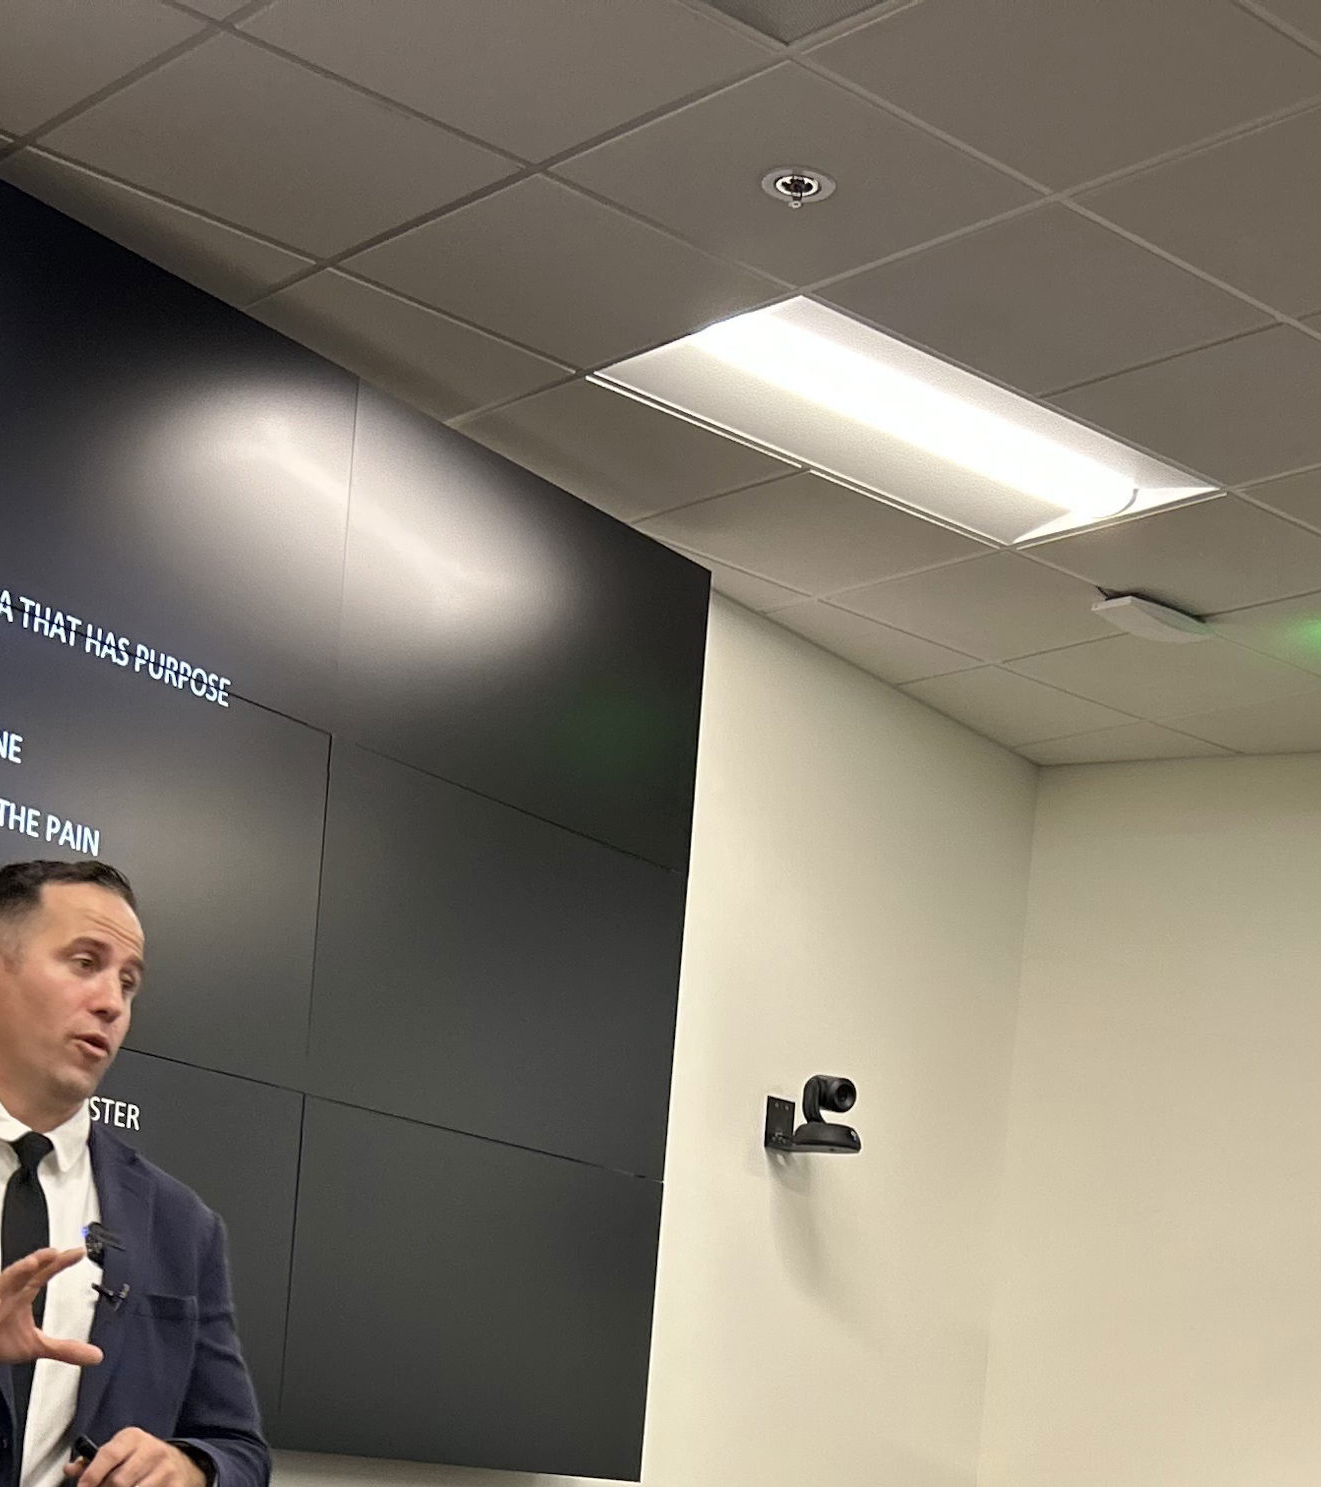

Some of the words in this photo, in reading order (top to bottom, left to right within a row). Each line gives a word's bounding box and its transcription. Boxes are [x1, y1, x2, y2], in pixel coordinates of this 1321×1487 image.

[19, 596, 83, 647] THAT
[84, 623, 130, 667] HAS
[134, 643, 232, 708] PURPOSE
[45, 814, 100, 857] PAIN
